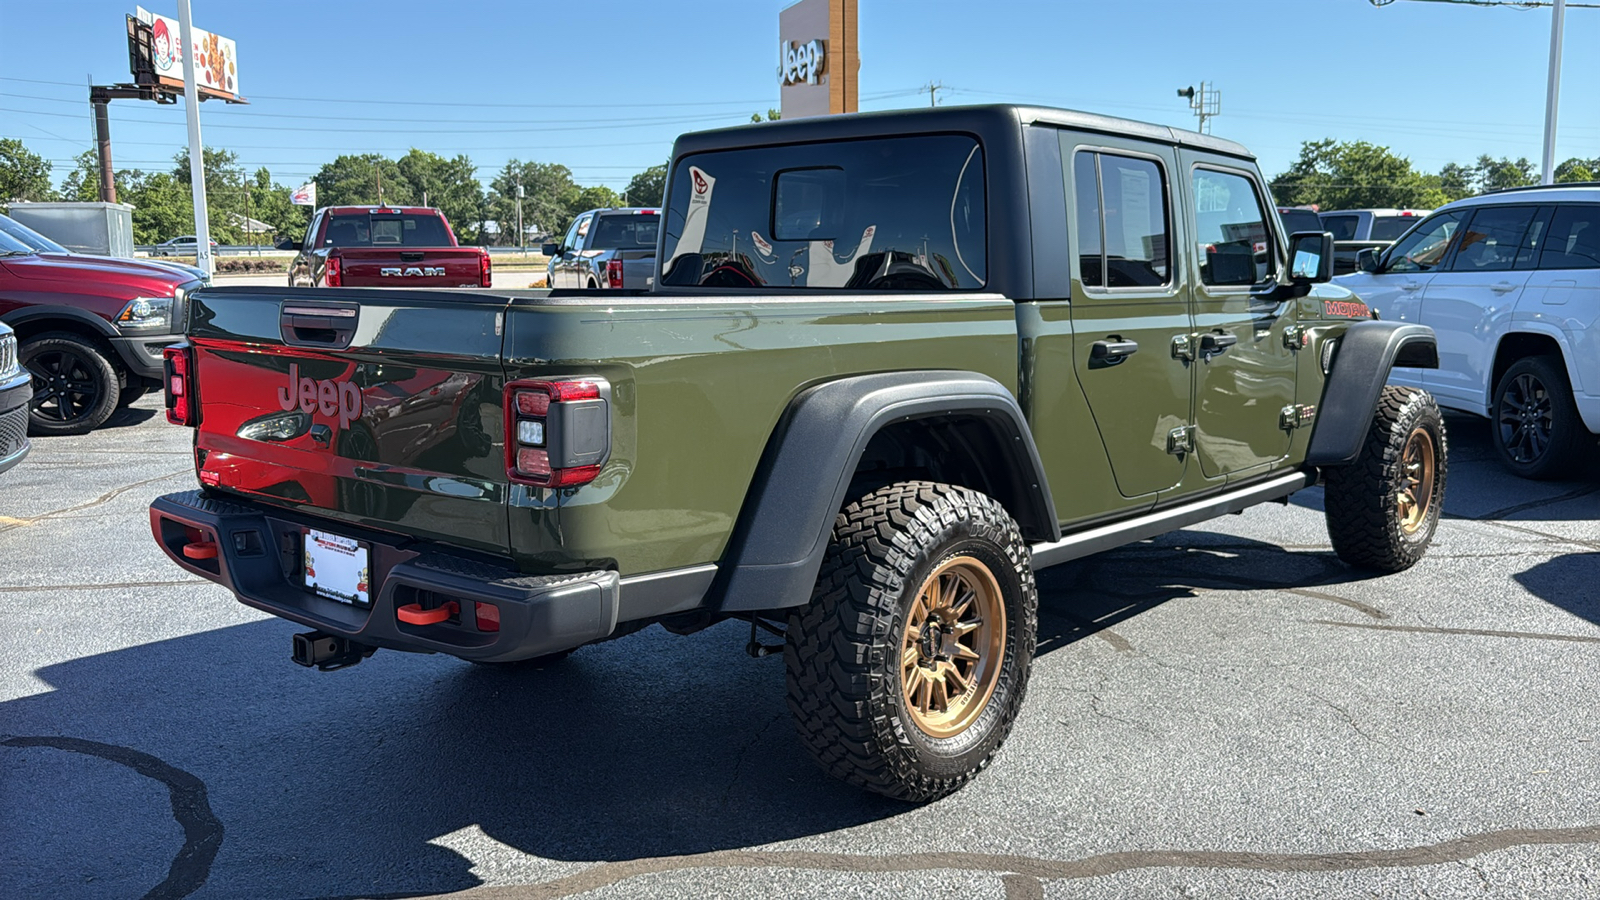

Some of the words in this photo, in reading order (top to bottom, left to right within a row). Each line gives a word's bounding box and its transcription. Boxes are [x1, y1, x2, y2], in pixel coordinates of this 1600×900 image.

[777, 40, 825, 85] Jeep
[381, 263, 445, 276] RAM
[278, 363, 362, 430] Jeep
